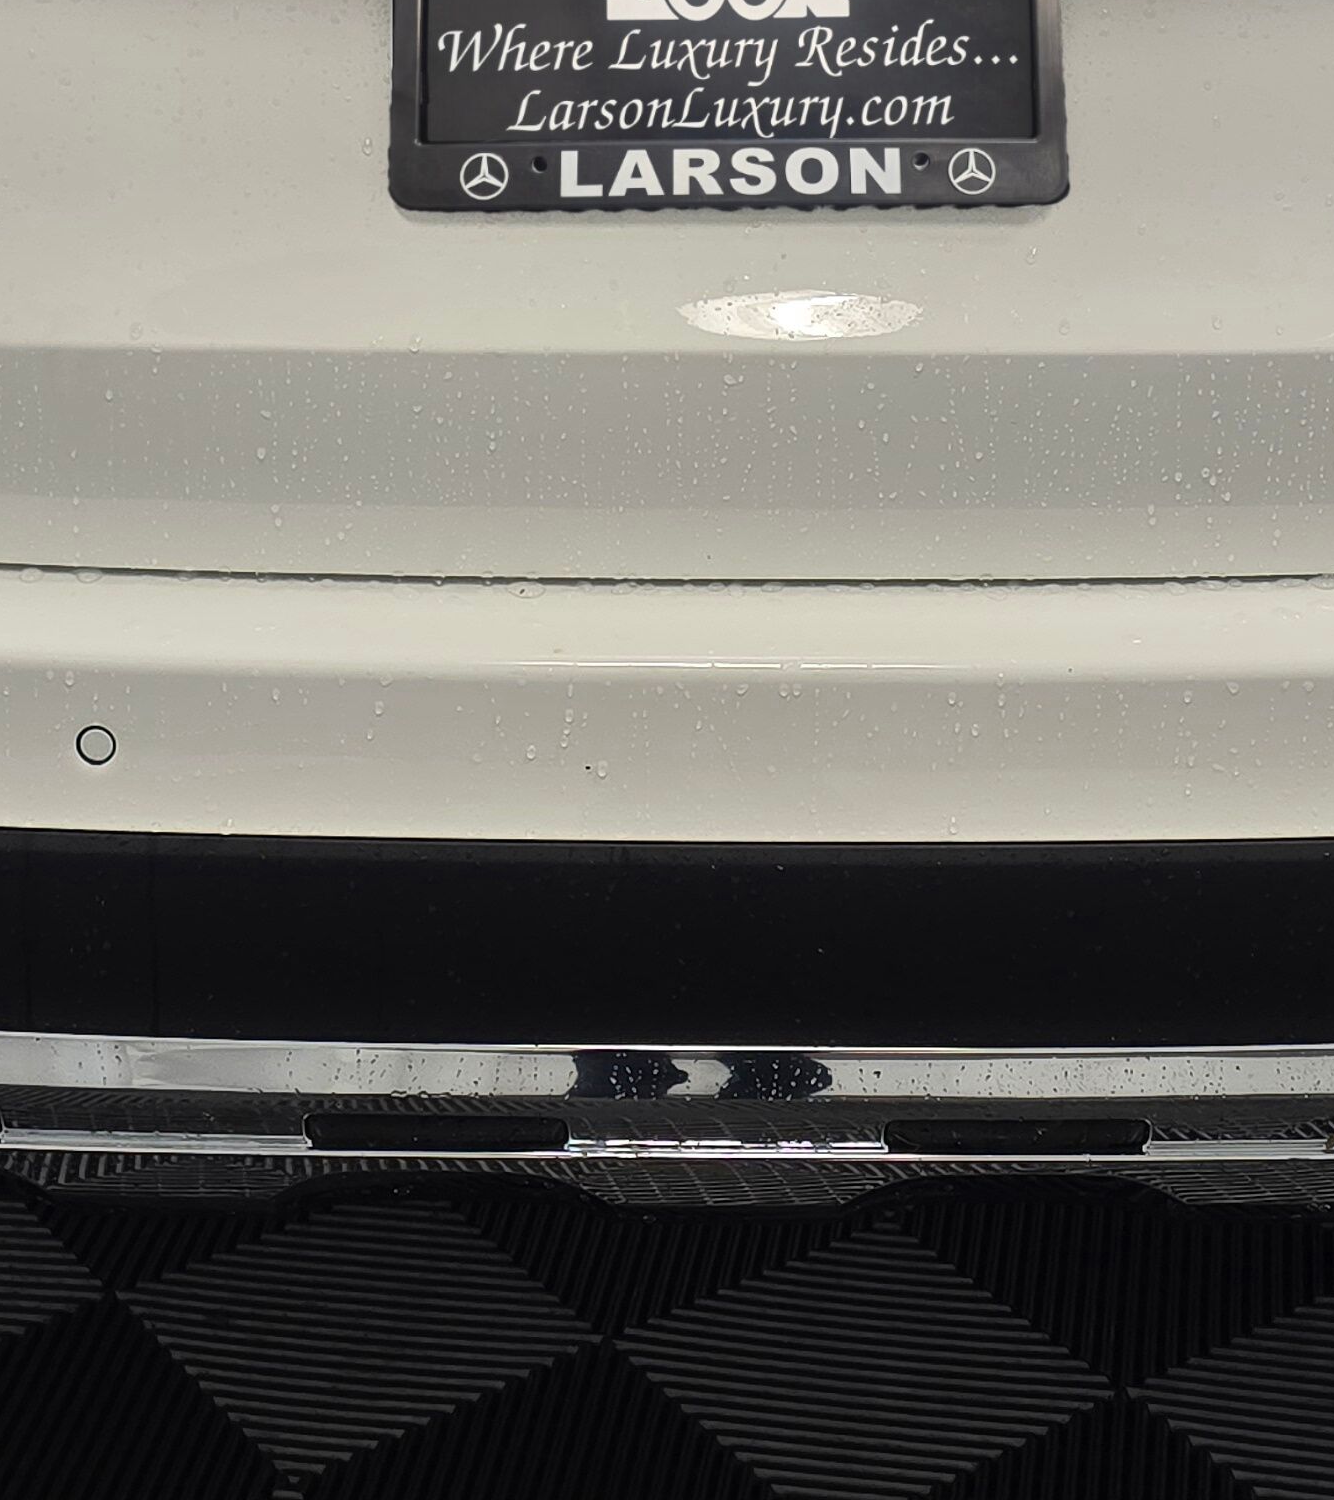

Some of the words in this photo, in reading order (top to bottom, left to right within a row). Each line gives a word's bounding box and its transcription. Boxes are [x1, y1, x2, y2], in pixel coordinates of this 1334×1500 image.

[437, 22, 594, 73] Where
[608, 28, 779, 87] Luxury
[794, 18, 1019, 78] Resides...
[506, 86, 955, 139] LarsonLuxury.com
[559, 147, 902, 198] LARSON
